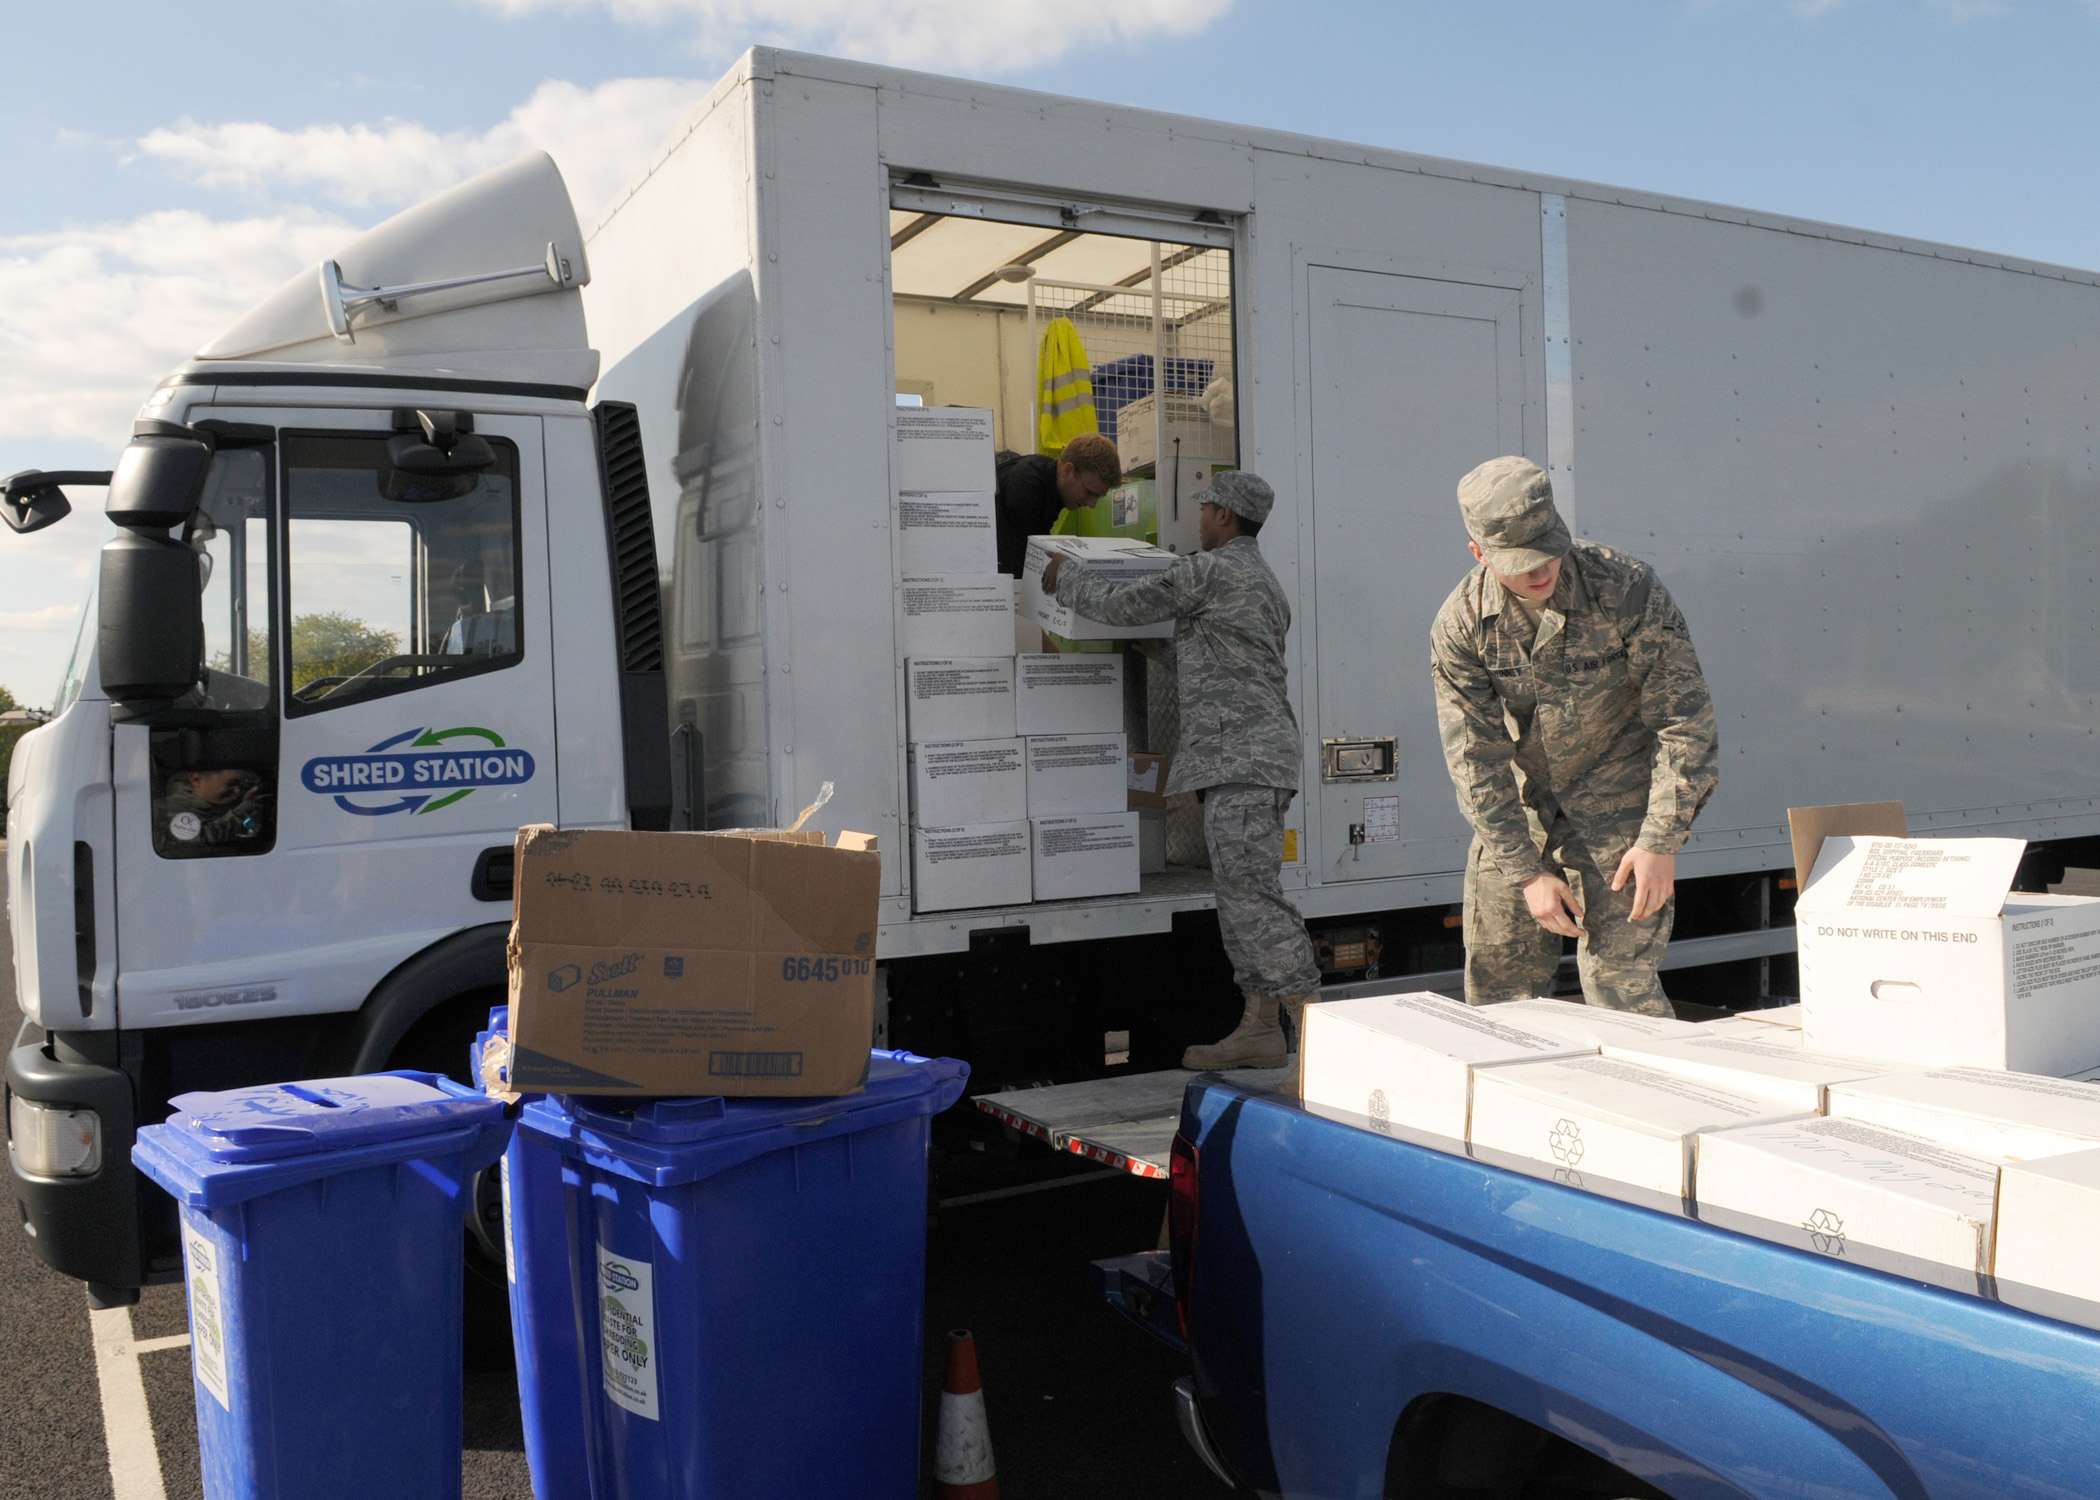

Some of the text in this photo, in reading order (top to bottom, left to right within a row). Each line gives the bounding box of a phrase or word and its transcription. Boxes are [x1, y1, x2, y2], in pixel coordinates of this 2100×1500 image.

[1584, 660, 1599, 672] AIR
[313, 756, 525, 787] SHRED STATION
[2012, 920, 2040, 931] INSTRUCTIONS
[1818, 927, 1978, 943] DO NOT WRITE ON THIS END
[586, 953, 641, 985] Scott
[782, 956, 872, 982] 6645 010
[586, 988, 639, 998] PULLMAN
[612, 1272, 637, 1289] STATION
[622, 1323, 638, 1337] FOR
[622, 1350, 648, 1368] ONLY
